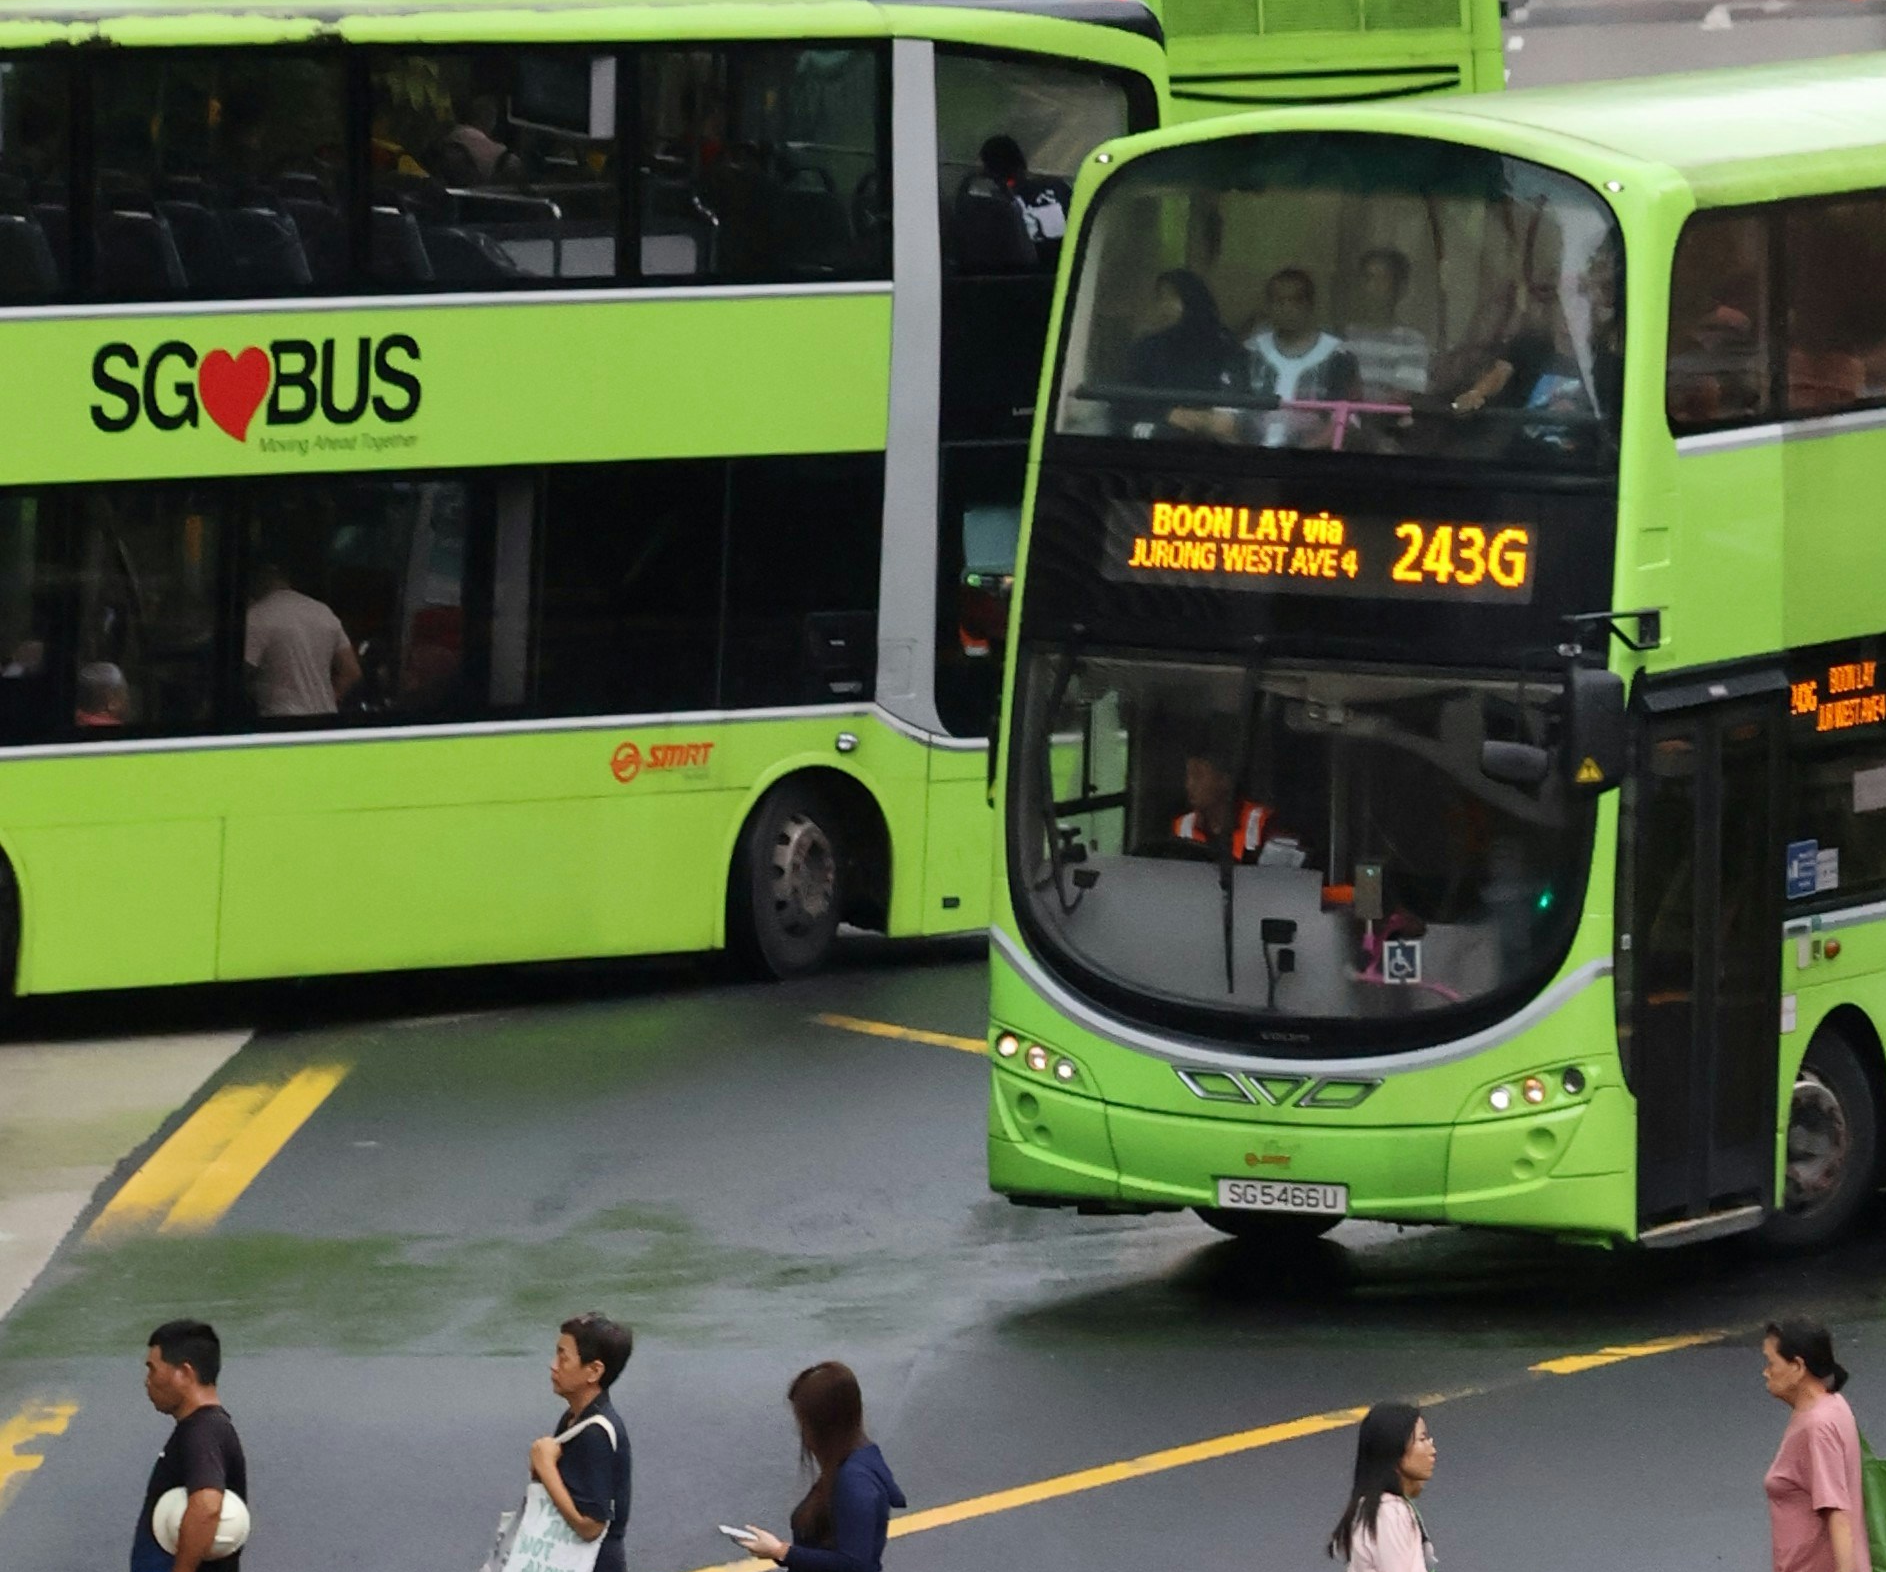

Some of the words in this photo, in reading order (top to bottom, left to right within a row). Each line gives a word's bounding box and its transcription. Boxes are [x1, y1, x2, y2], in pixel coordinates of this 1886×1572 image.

[1152, 502, 1233, 539] BOON
[1238, 507, 1299, 543] LAY
[1303, 512, 1345, 546] via
[1128, 538, 1216, 572] JURONG
[1220, 542, 1287, 575] WEST
[1288, 546, 1338, 578] AVE
[1340, 549, 1359, 579] 4
[1392, 521, 1530, 588] 243G
[646, 741, 715, 769] SMRT
[1228, 1182, 1338, 1209] SG5466U
[518, 1534, 555, 1562] NOT
